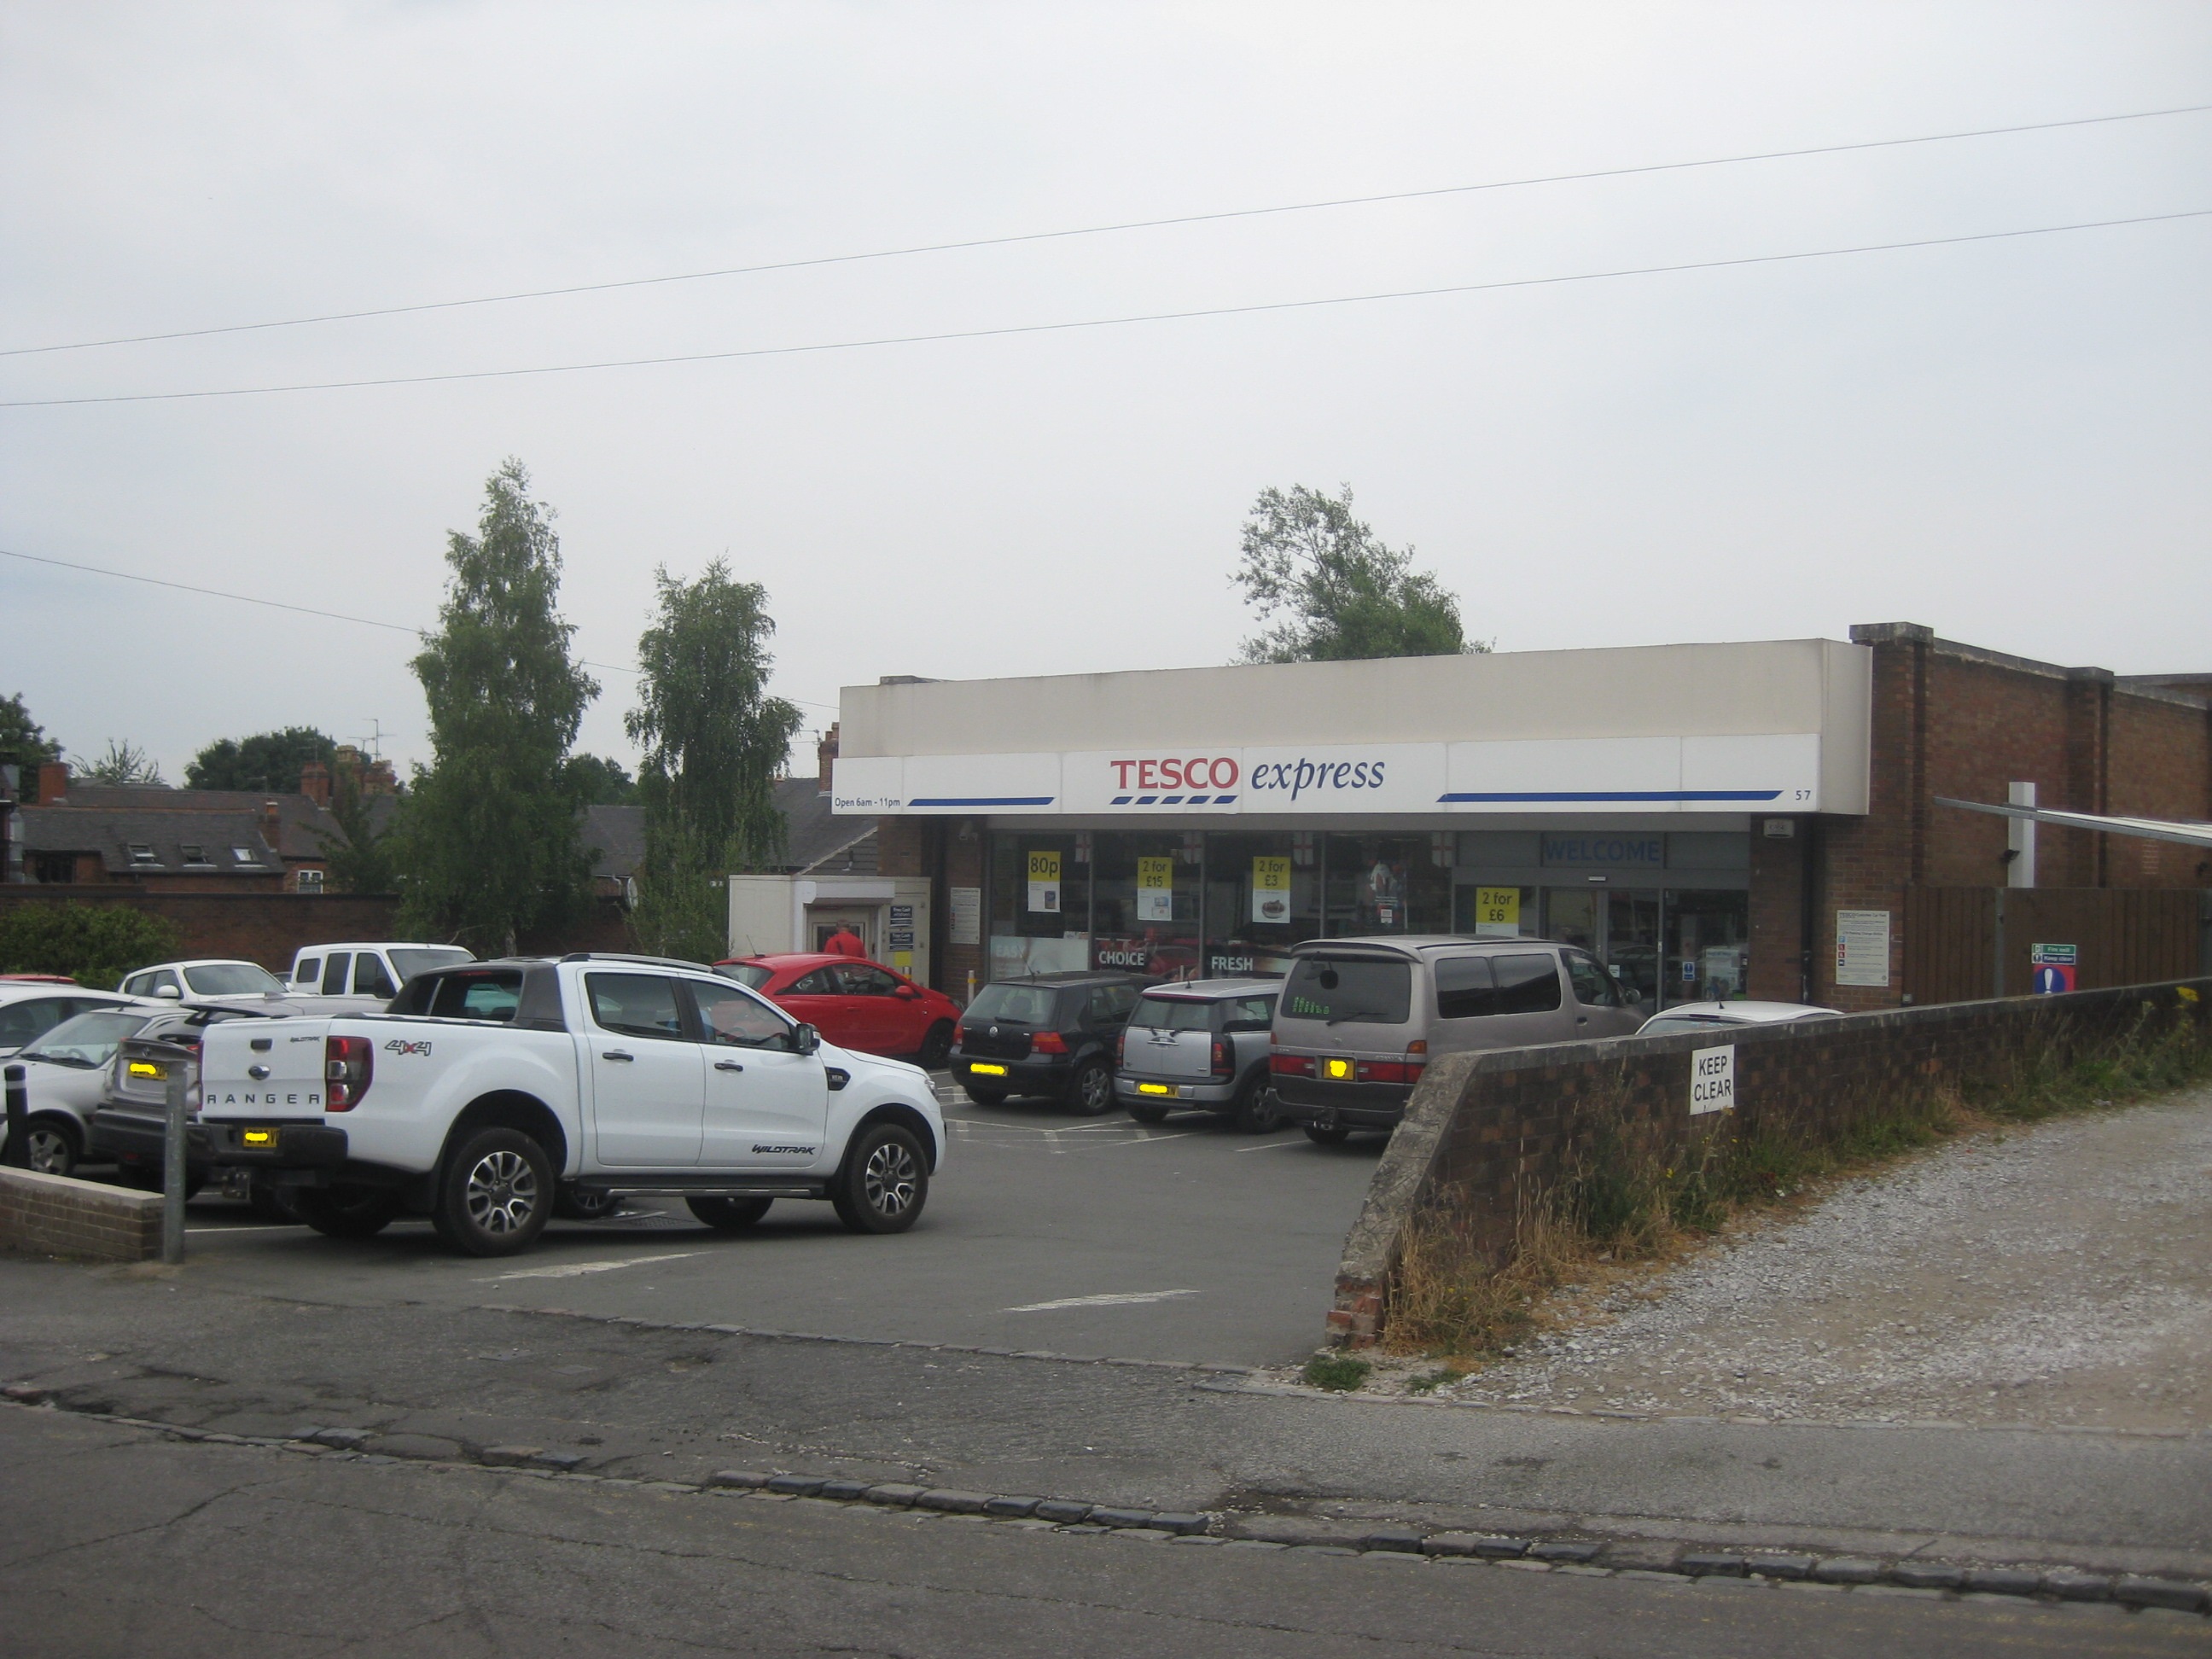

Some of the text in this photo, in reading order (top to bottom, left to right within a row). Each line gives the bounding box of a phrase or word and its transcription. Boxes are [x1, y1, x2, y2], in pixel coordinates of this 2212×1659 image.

[1110, 757, 1385, 800] TESCO express
[835, 797, 854, 808] Open
[856, 797, 872, 806] 6am
[880, 797, 900, 808] 11pm
[1545, 840, 1661, 862] WELCOME
[1030, 857, 1059, 877] 80p
[1143, 860, 1167, 872] 2 for
[1259, 860, 1285, 872] 2 for
[1146, 876, 1162, 888] £15
[1265, 875, 1278, 887] £3
[1482, 892, 1513, 905] 2 for
[1488, 909, 1505, 922] £6
[1098, 951, 1144, 966] CHOICE
[1212, 956, 1253, 971] FRESH
[1698, 1055, 1728, 1077] KEEP
[1694, 1079, 1732, 1103] CLEAR
[207, 1094, 320, 1104] RANGER
[752, 1144, 816, 1156] WILDTRAK
